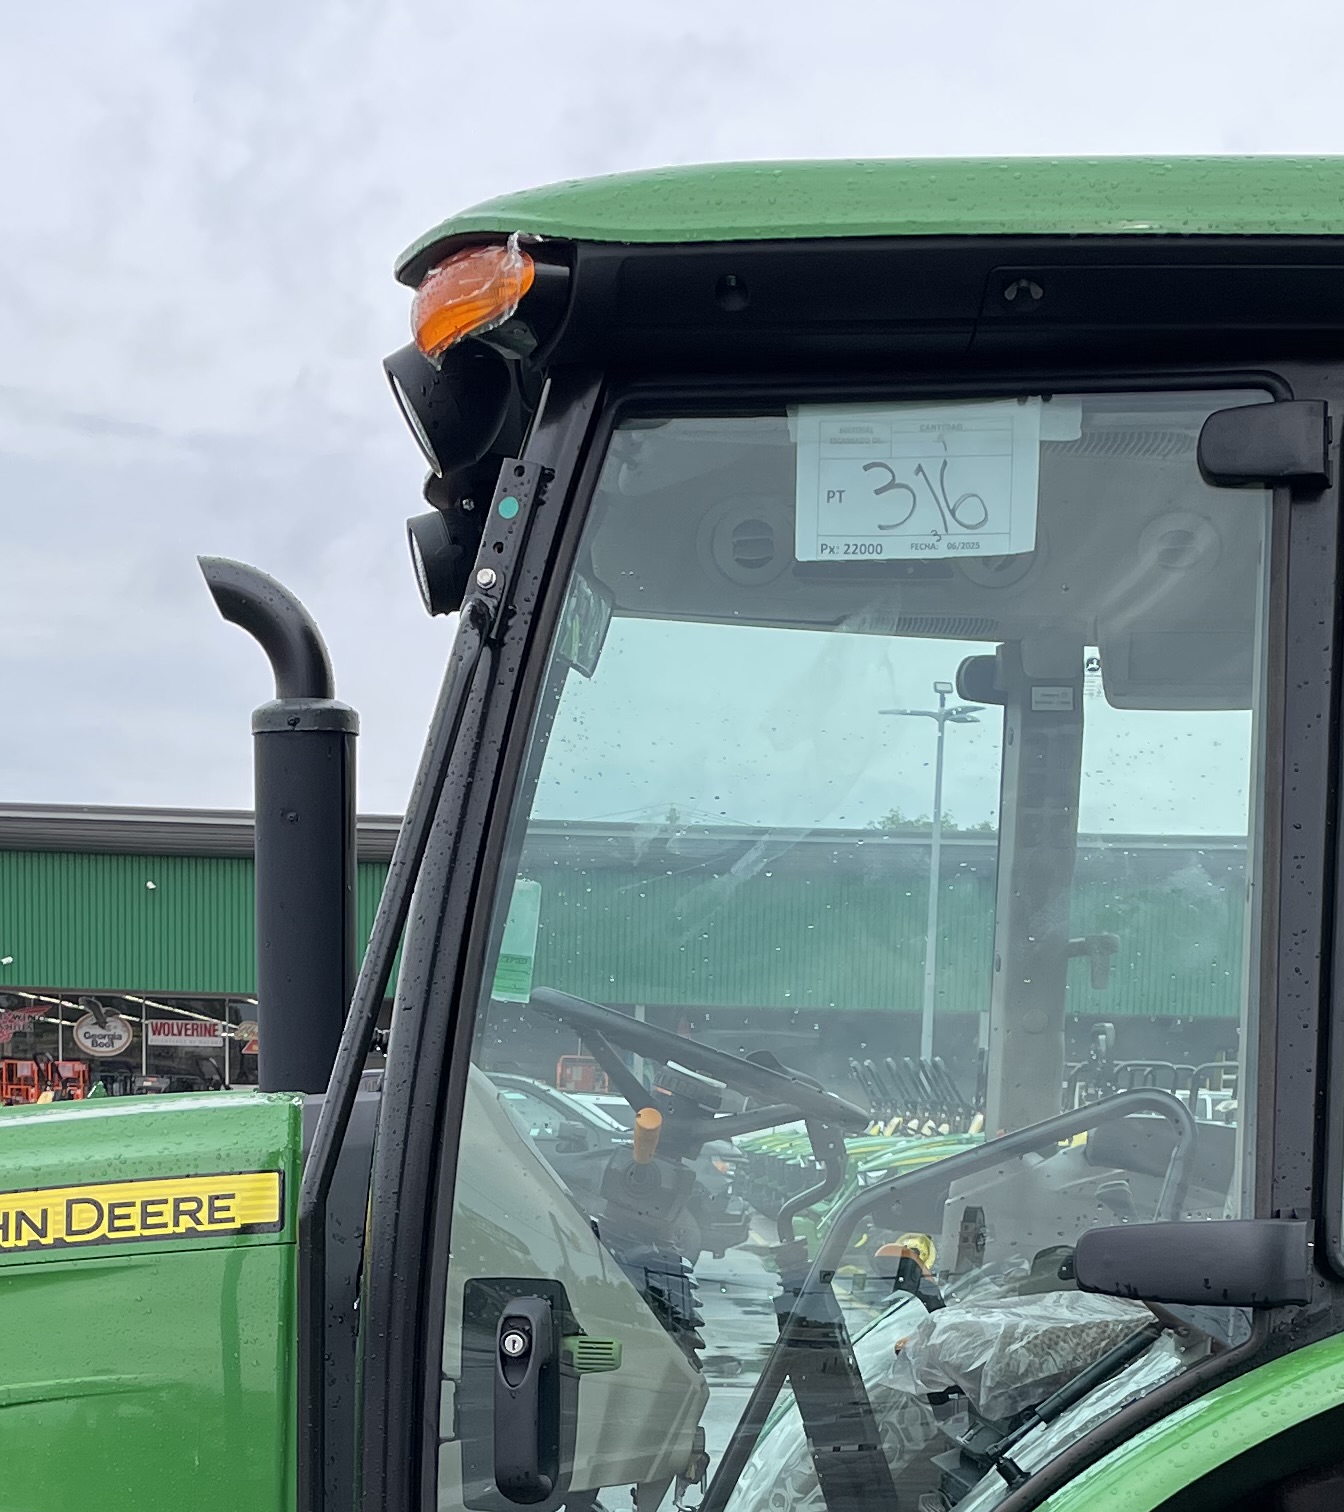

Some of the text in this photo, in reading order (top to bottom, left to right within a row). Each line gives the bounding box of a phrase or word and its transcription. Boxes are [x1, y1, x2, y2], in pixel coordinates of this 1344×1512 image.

[826, 490, 845, 503] PT
[863, 459, 988, 534] 316
[843, 543, 883, 555] 22000
[910, 542, 939, 551] FECHA:
[947, 541, 980, 550] 06/2025
[83, 1031, 123, 1042] Georgia
[150, 1021, 219, 1038] WOLVERINE
[63, 1192, 241, 1242] DEERE
